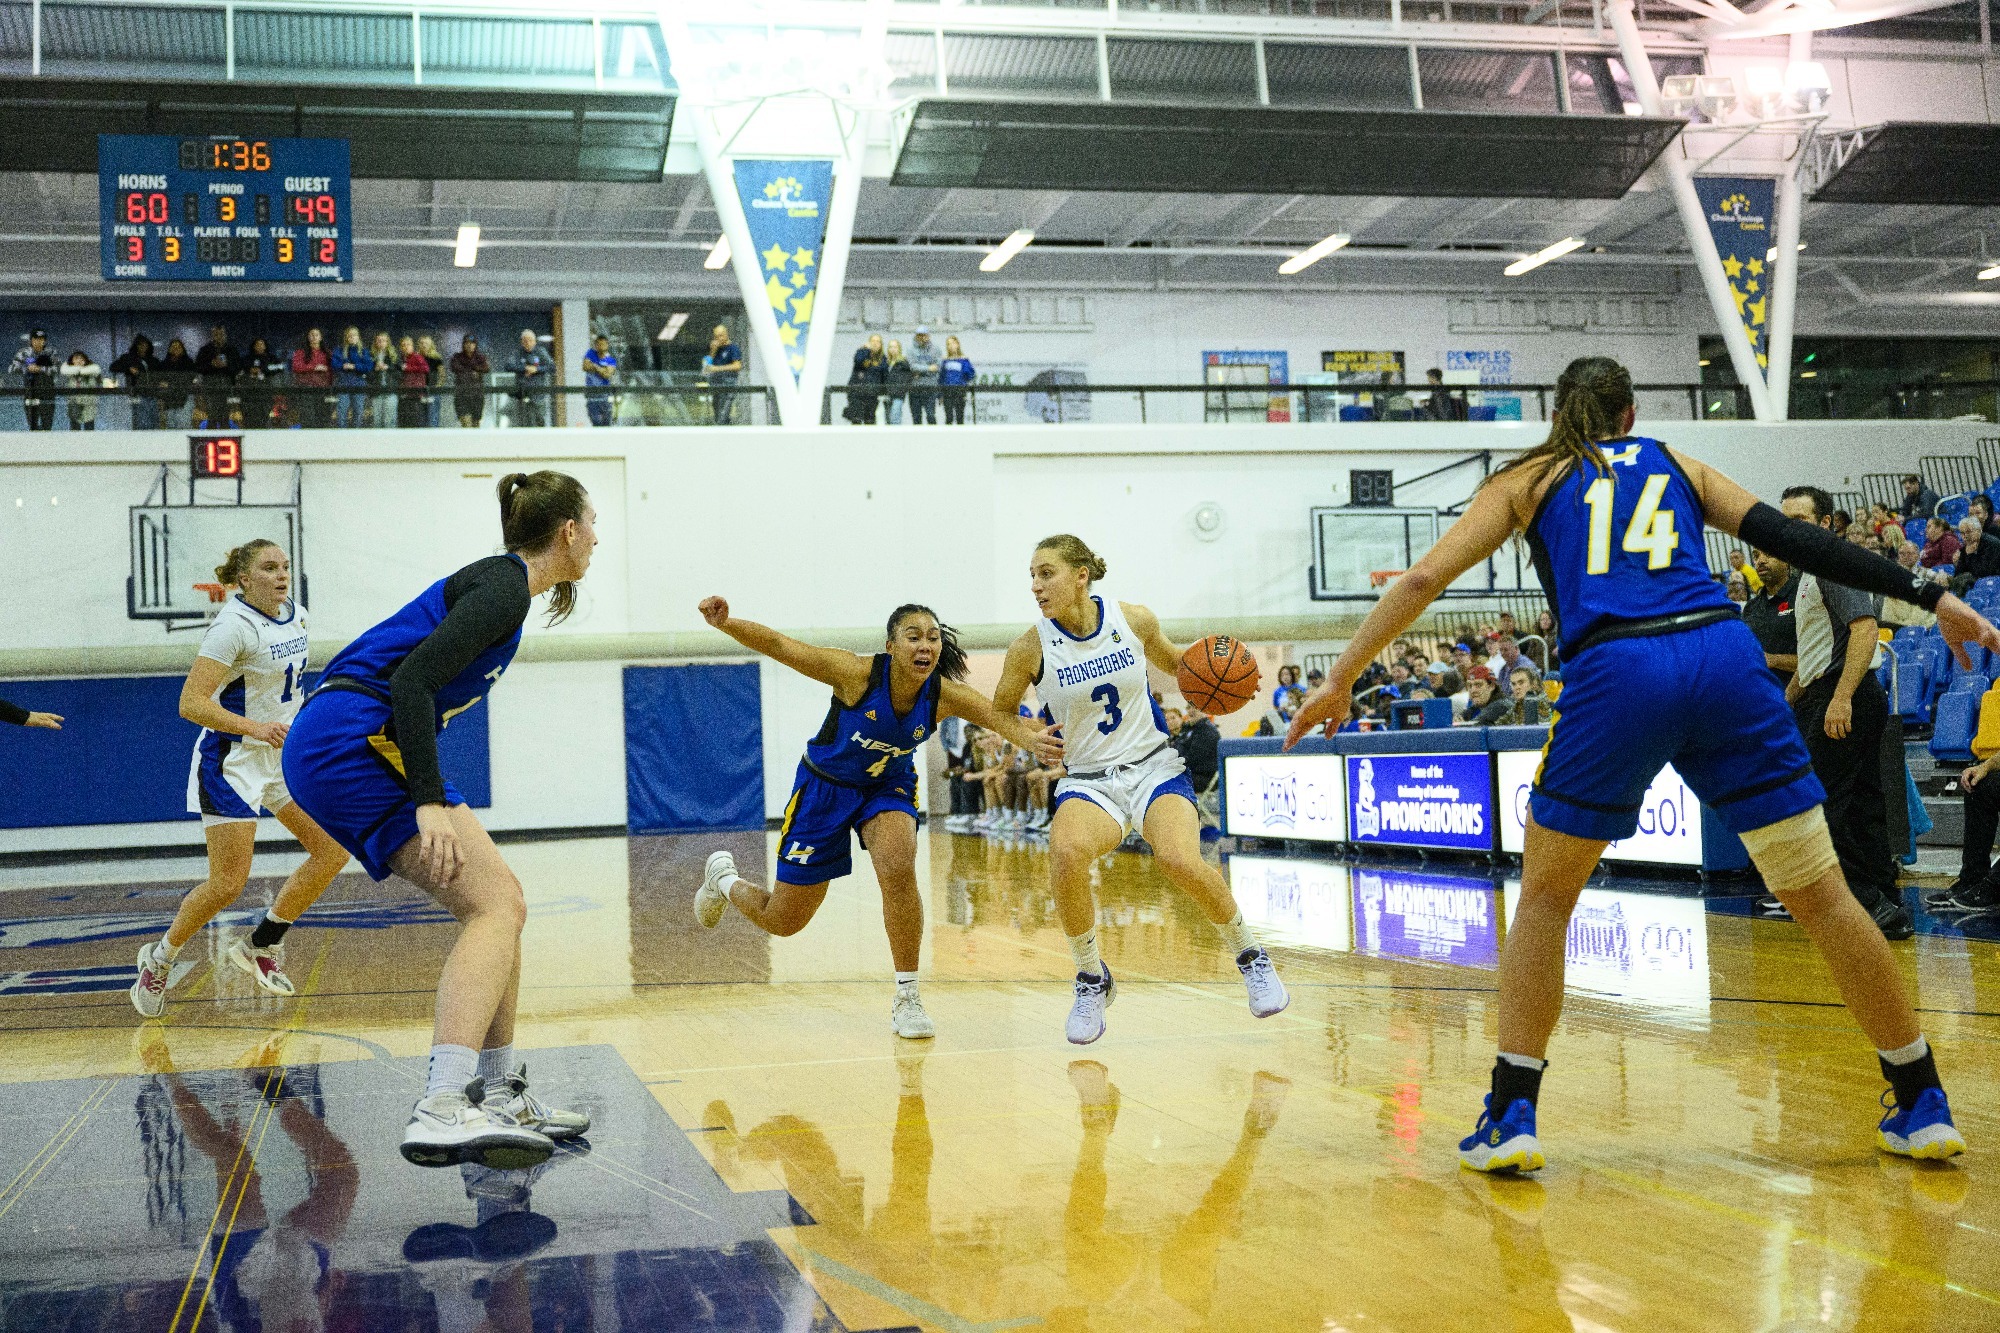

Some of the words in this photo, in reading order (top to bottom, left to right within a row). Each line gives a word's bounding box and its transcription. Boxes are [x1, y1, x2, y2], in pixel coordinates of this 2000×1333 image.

[213, 141, 271, 171] 1:36
[118, 174, 168, 190] HORNS
[208, 183, 244, 195] PERIOD
[284, 176, 331, 192] GUEST
[127, 193, 168, 223] 60
[220, 197, 236, 222] 3
[295, 195, 336, 224] 49
[114, 226, 146, 237] FOULS
[156, 227, 184, 237] T.O.L.
[193, 226, 231, 237] PLAYER
[235, 226, 261, 238] FOUL
[269, 227, 297, 238] T.O.L.
[307, 227, 339, 239] FOULS
[128, 237, 143, 262] 3
[164, 237, 180, 262] 3
[277, 238, 293, 263] 3
[319, 238, 337, 263] 2
[114, 265, 147, 277] SCORE
[211, 265, 245, 277] MATCH
[308, 266, 340, 278] SCORE
[208, 440, 237, 474] 13
[1584, 474, 1679, 575] 14
[1057, 647, 1135, 688] PRONGHORNS
[1091, 683, 1122, 735] 3
[866, 755, 890, 777] 4
[1380, 801, 1484, 836] PRONGHORNS
